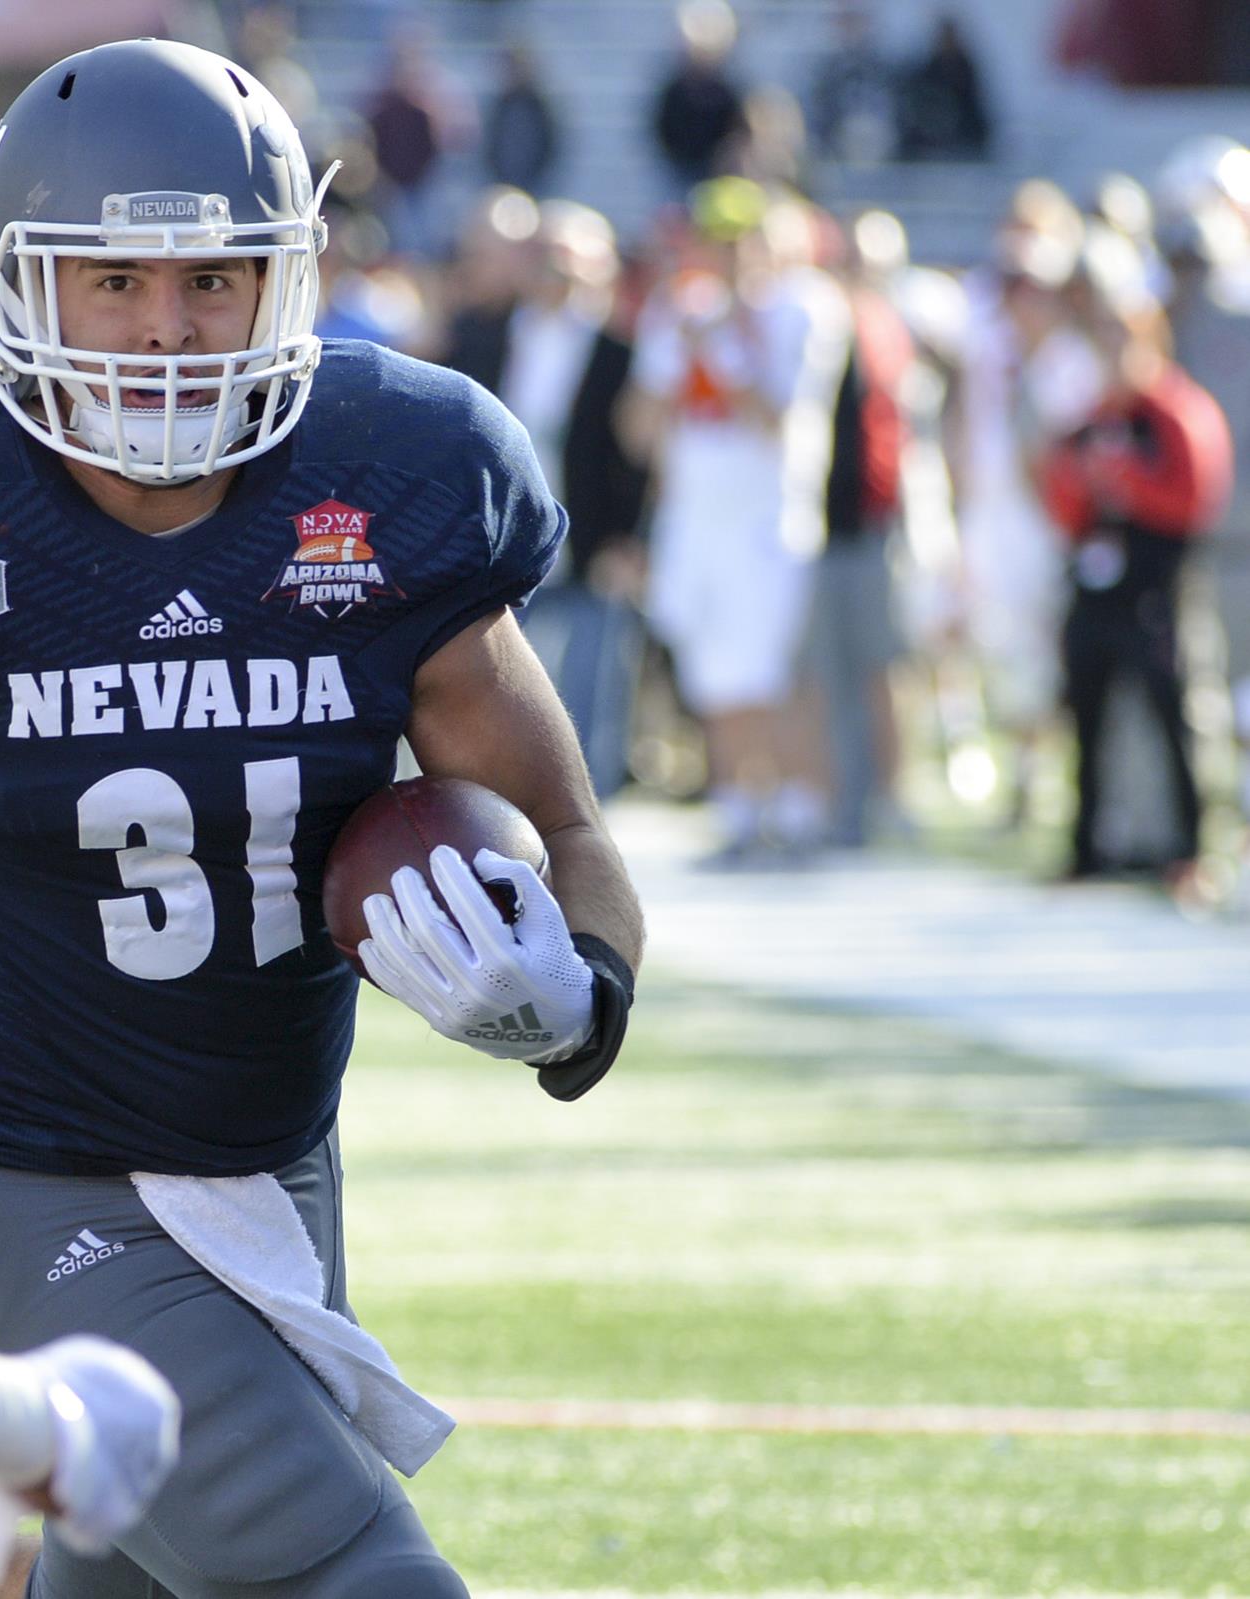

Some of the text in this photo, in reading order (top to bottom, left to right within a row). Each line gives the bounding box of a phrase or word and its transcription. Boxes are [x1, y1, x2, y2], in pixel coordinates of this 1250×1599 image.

[132, 201, 197, 217] NEVADA
[280, 563, 384, 587] ARIZONA
[300, 583, 368, 605] BOWL
[139, 617, 224, 640] adidas
[8, 655, 356, 739] NEVADA
[77, 756, 306, 981] 31
[464, 1028, 553, 1043] adidas
[47, 1242, 125, 1281] adidas
